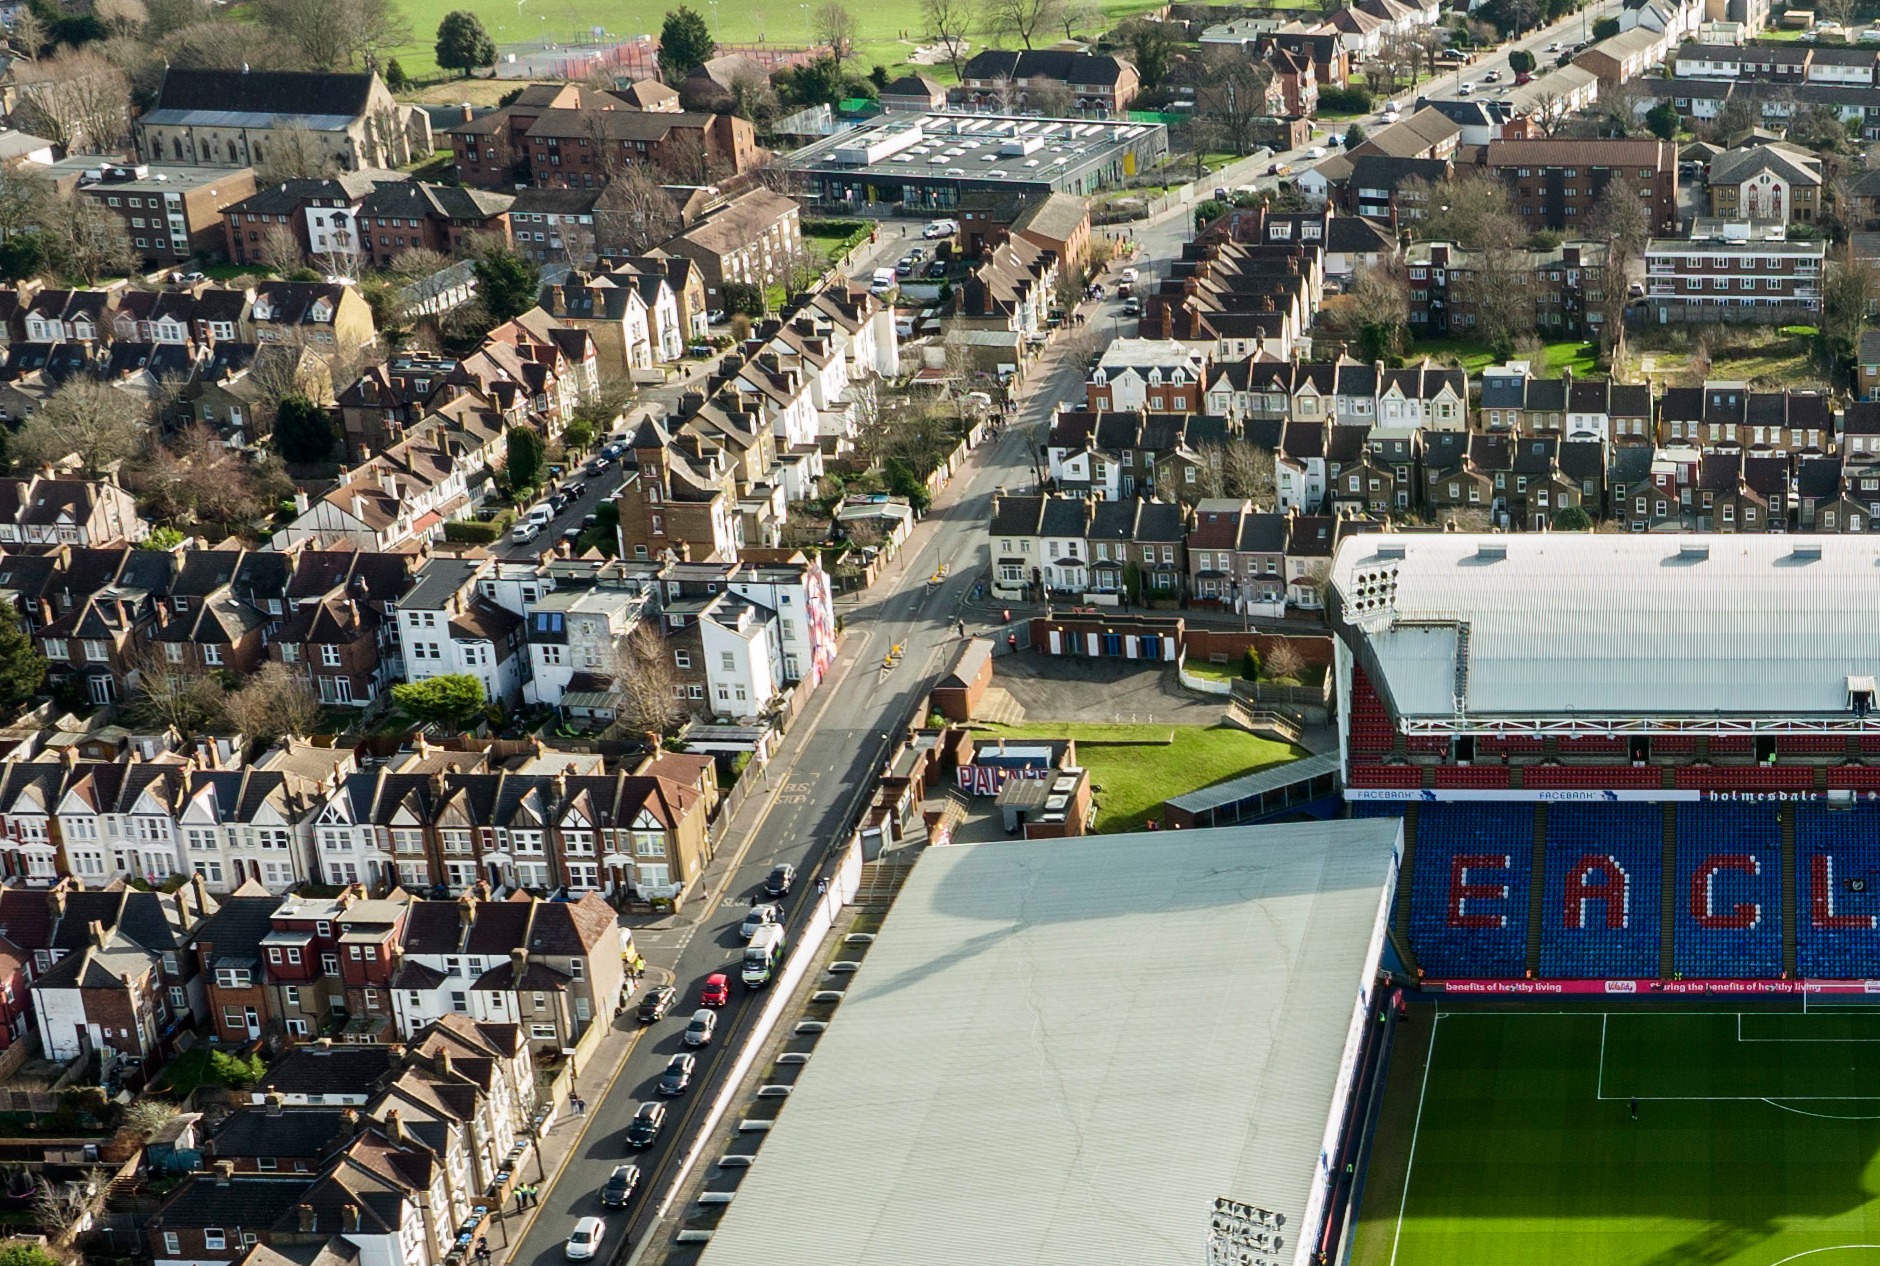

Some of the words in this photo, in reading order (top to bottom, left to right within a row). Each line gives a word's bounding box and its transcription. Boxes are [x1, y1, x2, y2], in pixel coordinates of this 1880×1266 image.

[1357, 791, 1412, 799] FACEBANK
[1539, 792, 1594, 800] FACEBANK
[1709, 790, 1818, 801] holmesdale
[1446, 983, 1485, 991] benefits
[1487, 983, 1497, 991] of
[1499, 983, 1533, 993] helthy
[1535, 983, 1562, 993] living
[1688, 983, 1703, 991] the
[1746, 983, 1757, 991] of
[1759, 983, 1793, 993] helthy
